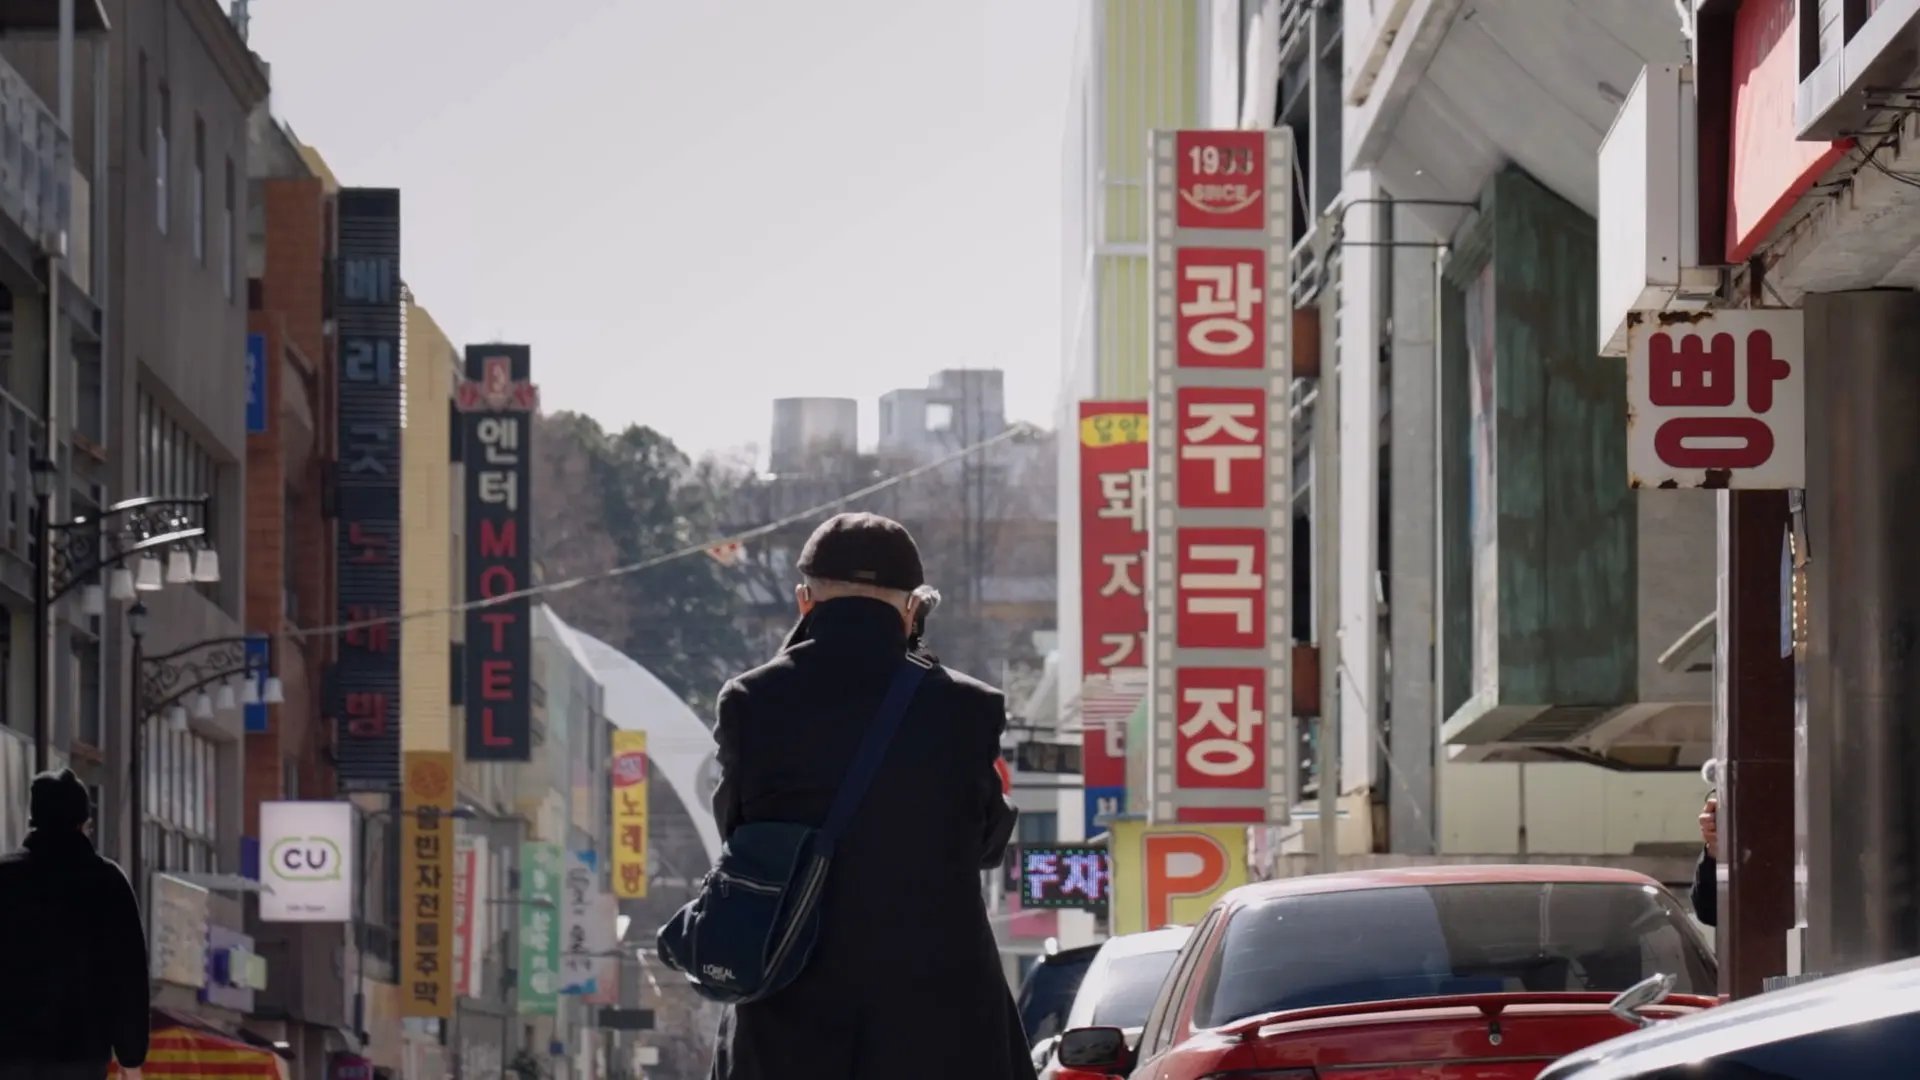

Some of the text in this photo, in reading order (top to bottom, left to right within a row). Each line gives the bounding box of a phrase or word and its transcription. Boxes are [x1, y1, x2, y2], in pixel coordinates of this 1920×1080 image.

[1648, 328, 1791, 469] 빵
[1179, 262, 1263, 777] 광주극장
[477, 417, 519, 747] 엔터 MOTEL
[283, 847, 327, 870] CU
[1027, 853, 1109, 900] 주차
[1144, 833, 1228, 932] P
